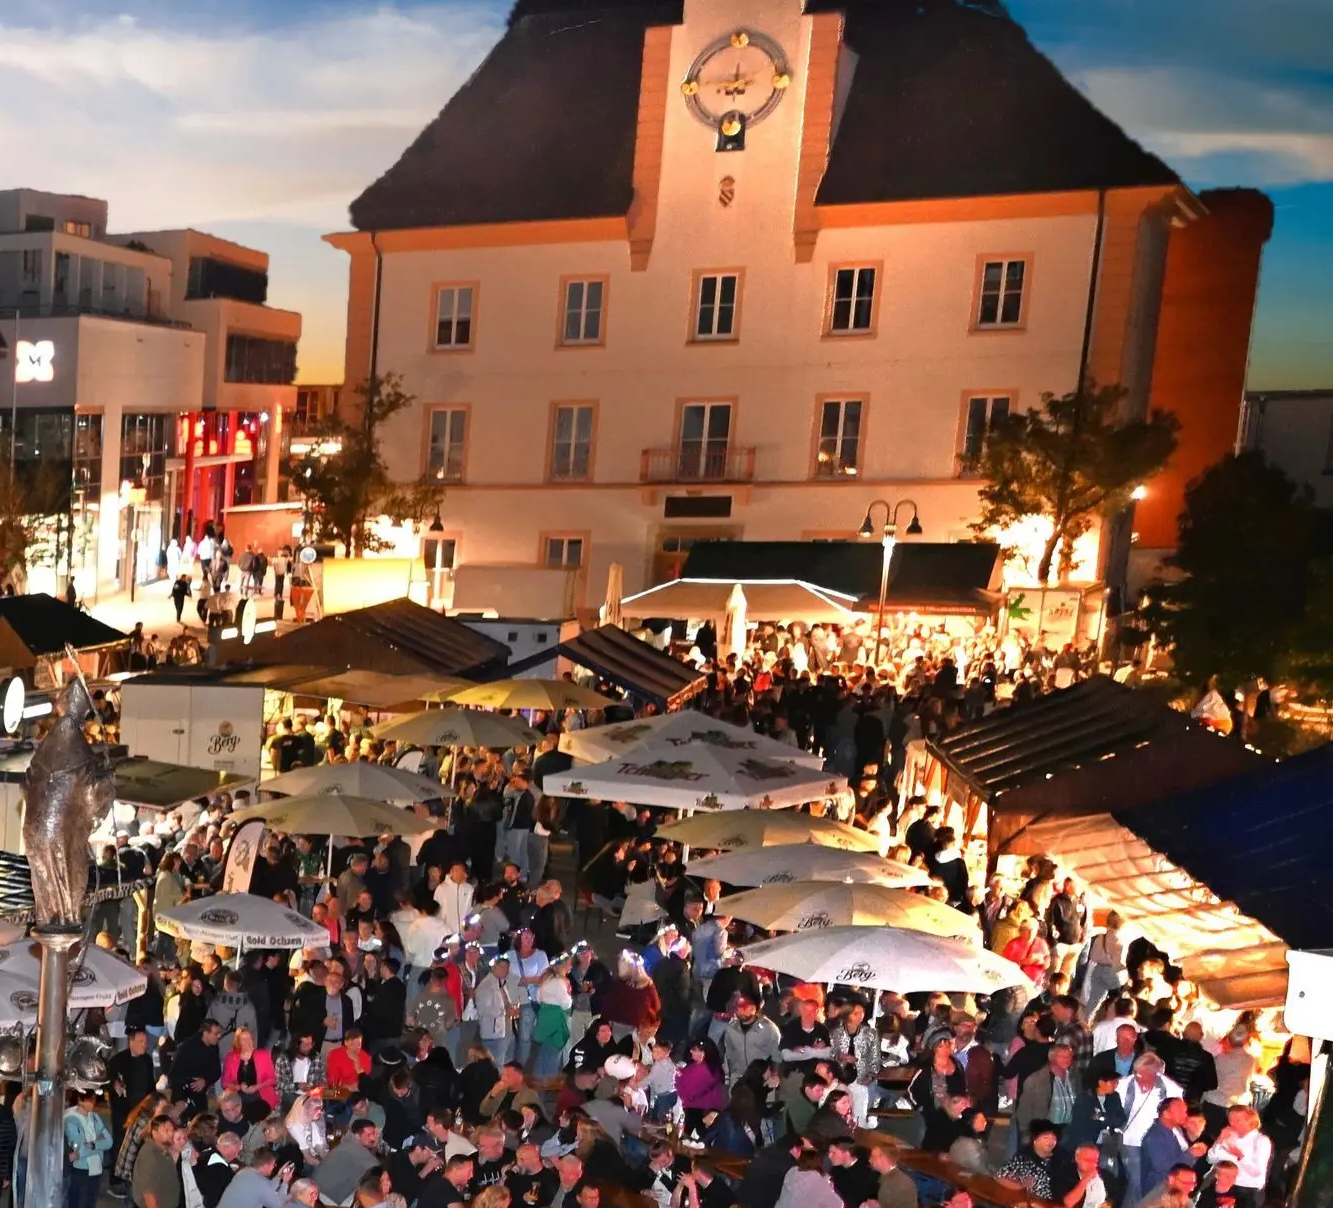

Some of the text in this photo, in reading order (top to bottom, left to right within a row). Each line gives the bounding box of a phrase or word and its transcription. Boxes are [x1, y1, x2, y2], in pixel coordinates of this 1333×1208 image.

[246, 935, 303, 946] Gold Ochsen
[836, 967, 877, 983] Berg
